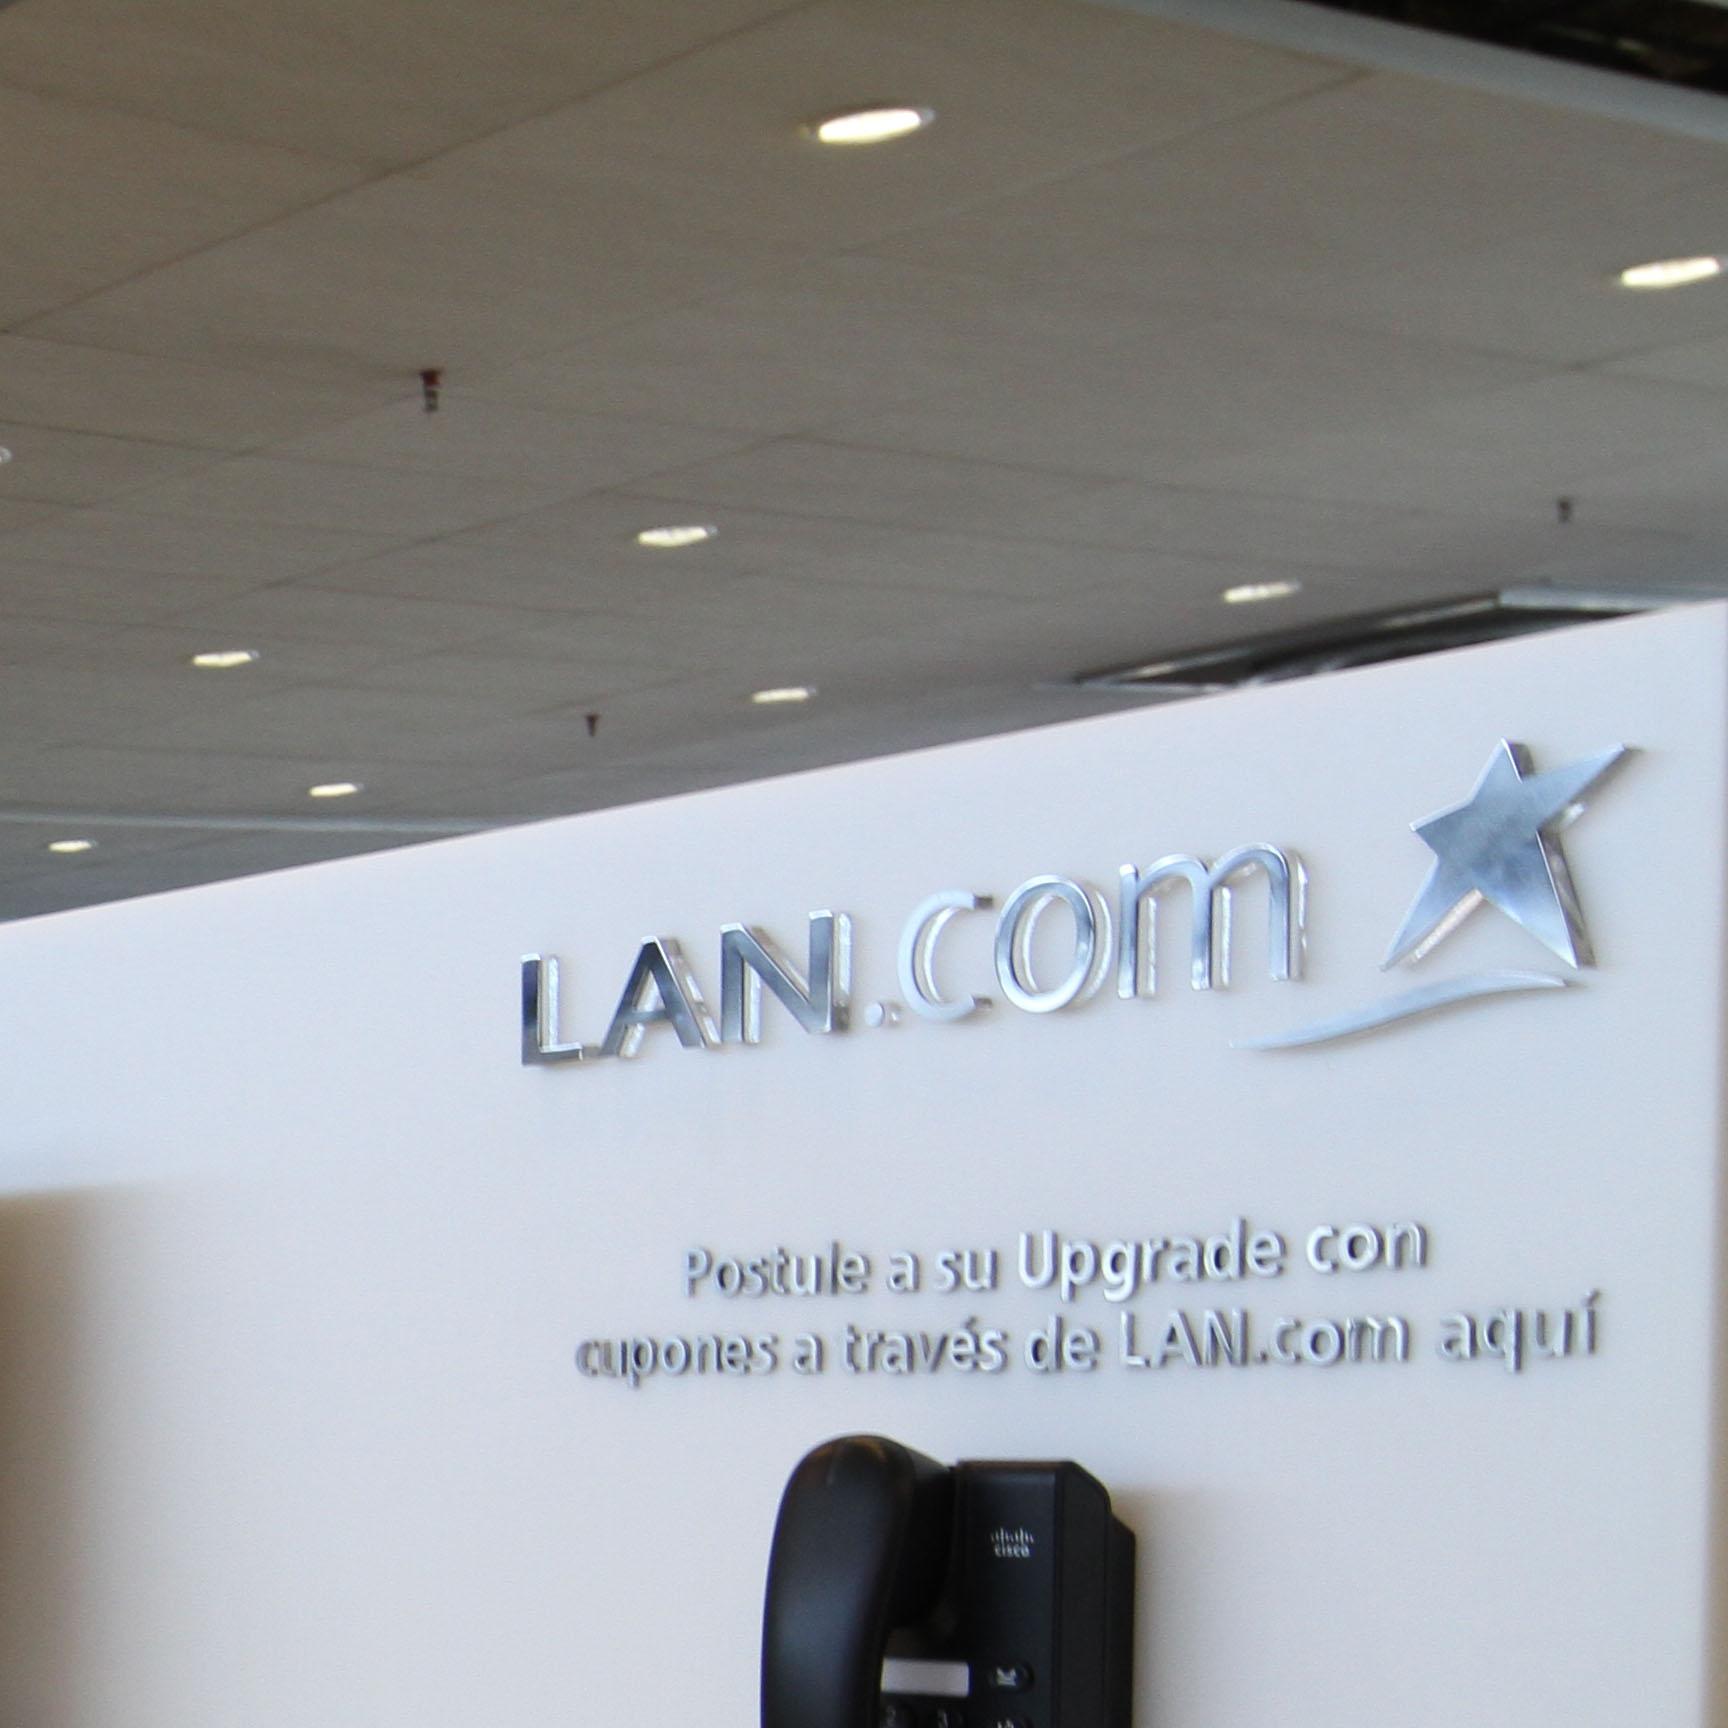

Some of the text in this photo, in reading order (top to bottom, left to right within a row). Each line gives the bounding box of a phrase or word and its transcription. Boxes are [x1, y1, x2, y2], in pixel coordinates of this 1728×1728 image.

[521, 842, 1308, 1066] LAN.com
[680, 1214, 1431, 1305] Postule a su Upgrade con
[574, 1288, 1605, 1388] cupones a través de LAN.com aquí
[994, 1543, 1030, 1558] cisco
